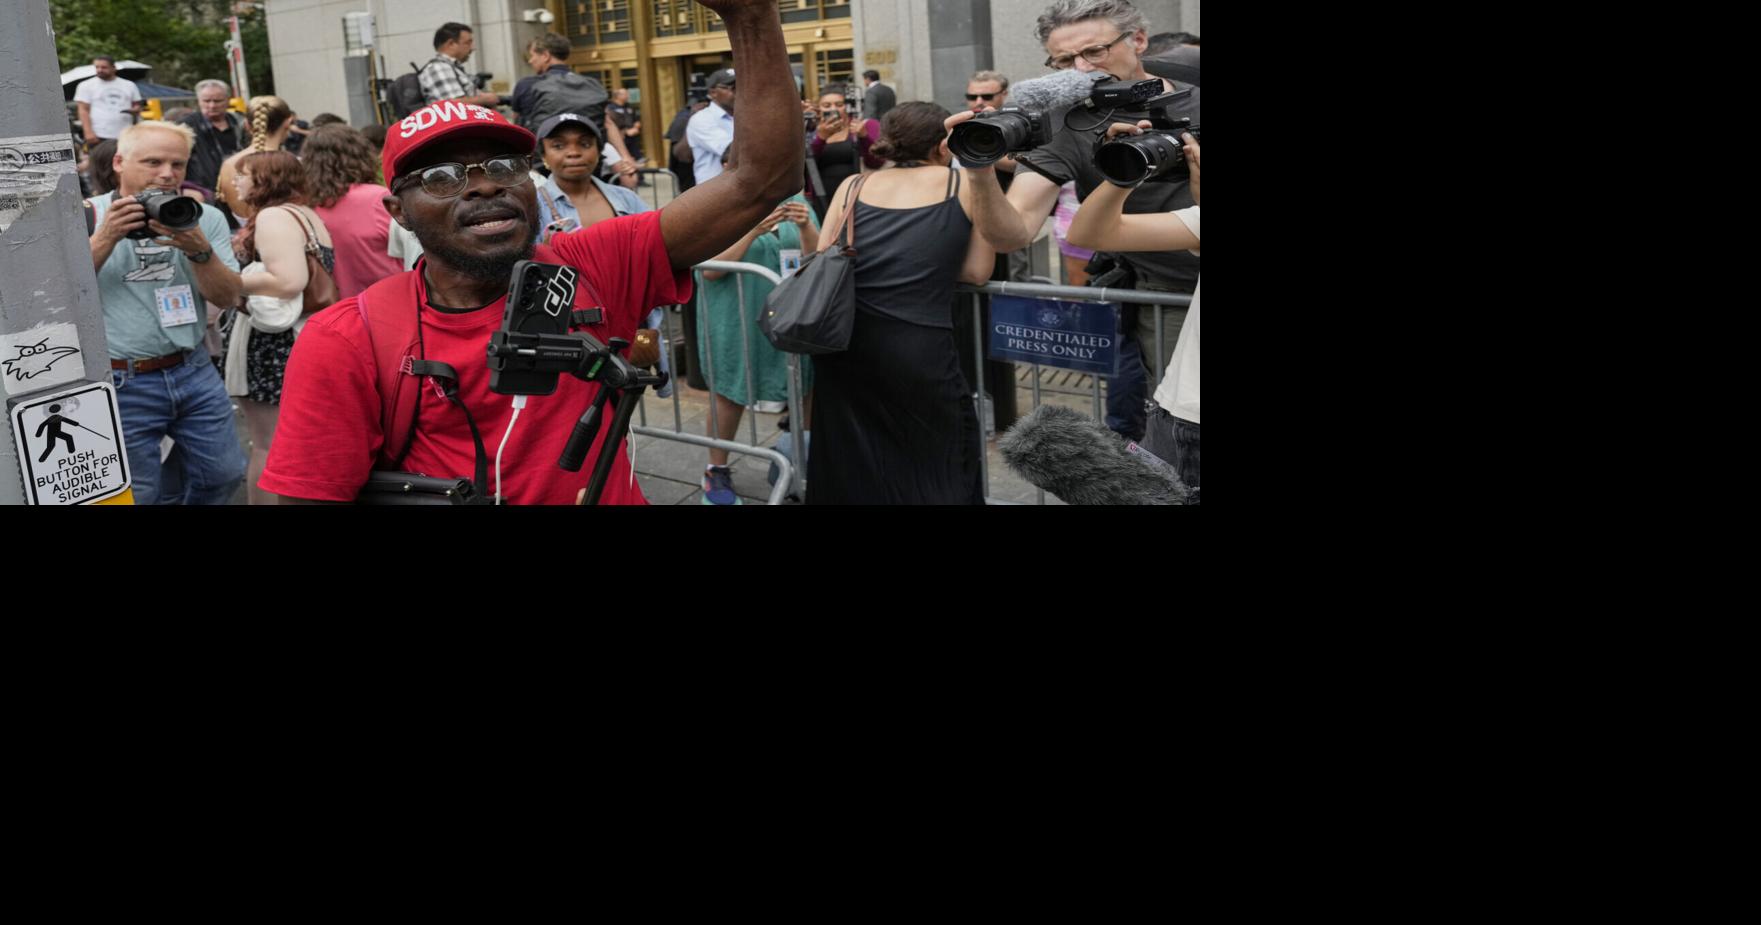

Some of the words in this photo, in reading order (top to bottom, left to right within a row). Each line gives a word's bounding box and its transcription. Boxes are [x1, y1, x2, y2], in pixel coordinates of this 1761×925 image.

[400, 101, 468, 138] SDW
[544, 265, 575, 316] DJI
[995, 324, 1111, 348] CREDENTIALED
[1008, 338, 1048, 353] PRESS
[1052, 344, 1096, 359] ONLY
[36, 462, 90, 488] BUTTON
[93, 453, 118, 469] FOR
[58, 450, 95, 469] PUSH
[53, 467, 110, 494] AUDIBLE
[58, 481, 107, 503] SIGNAL
